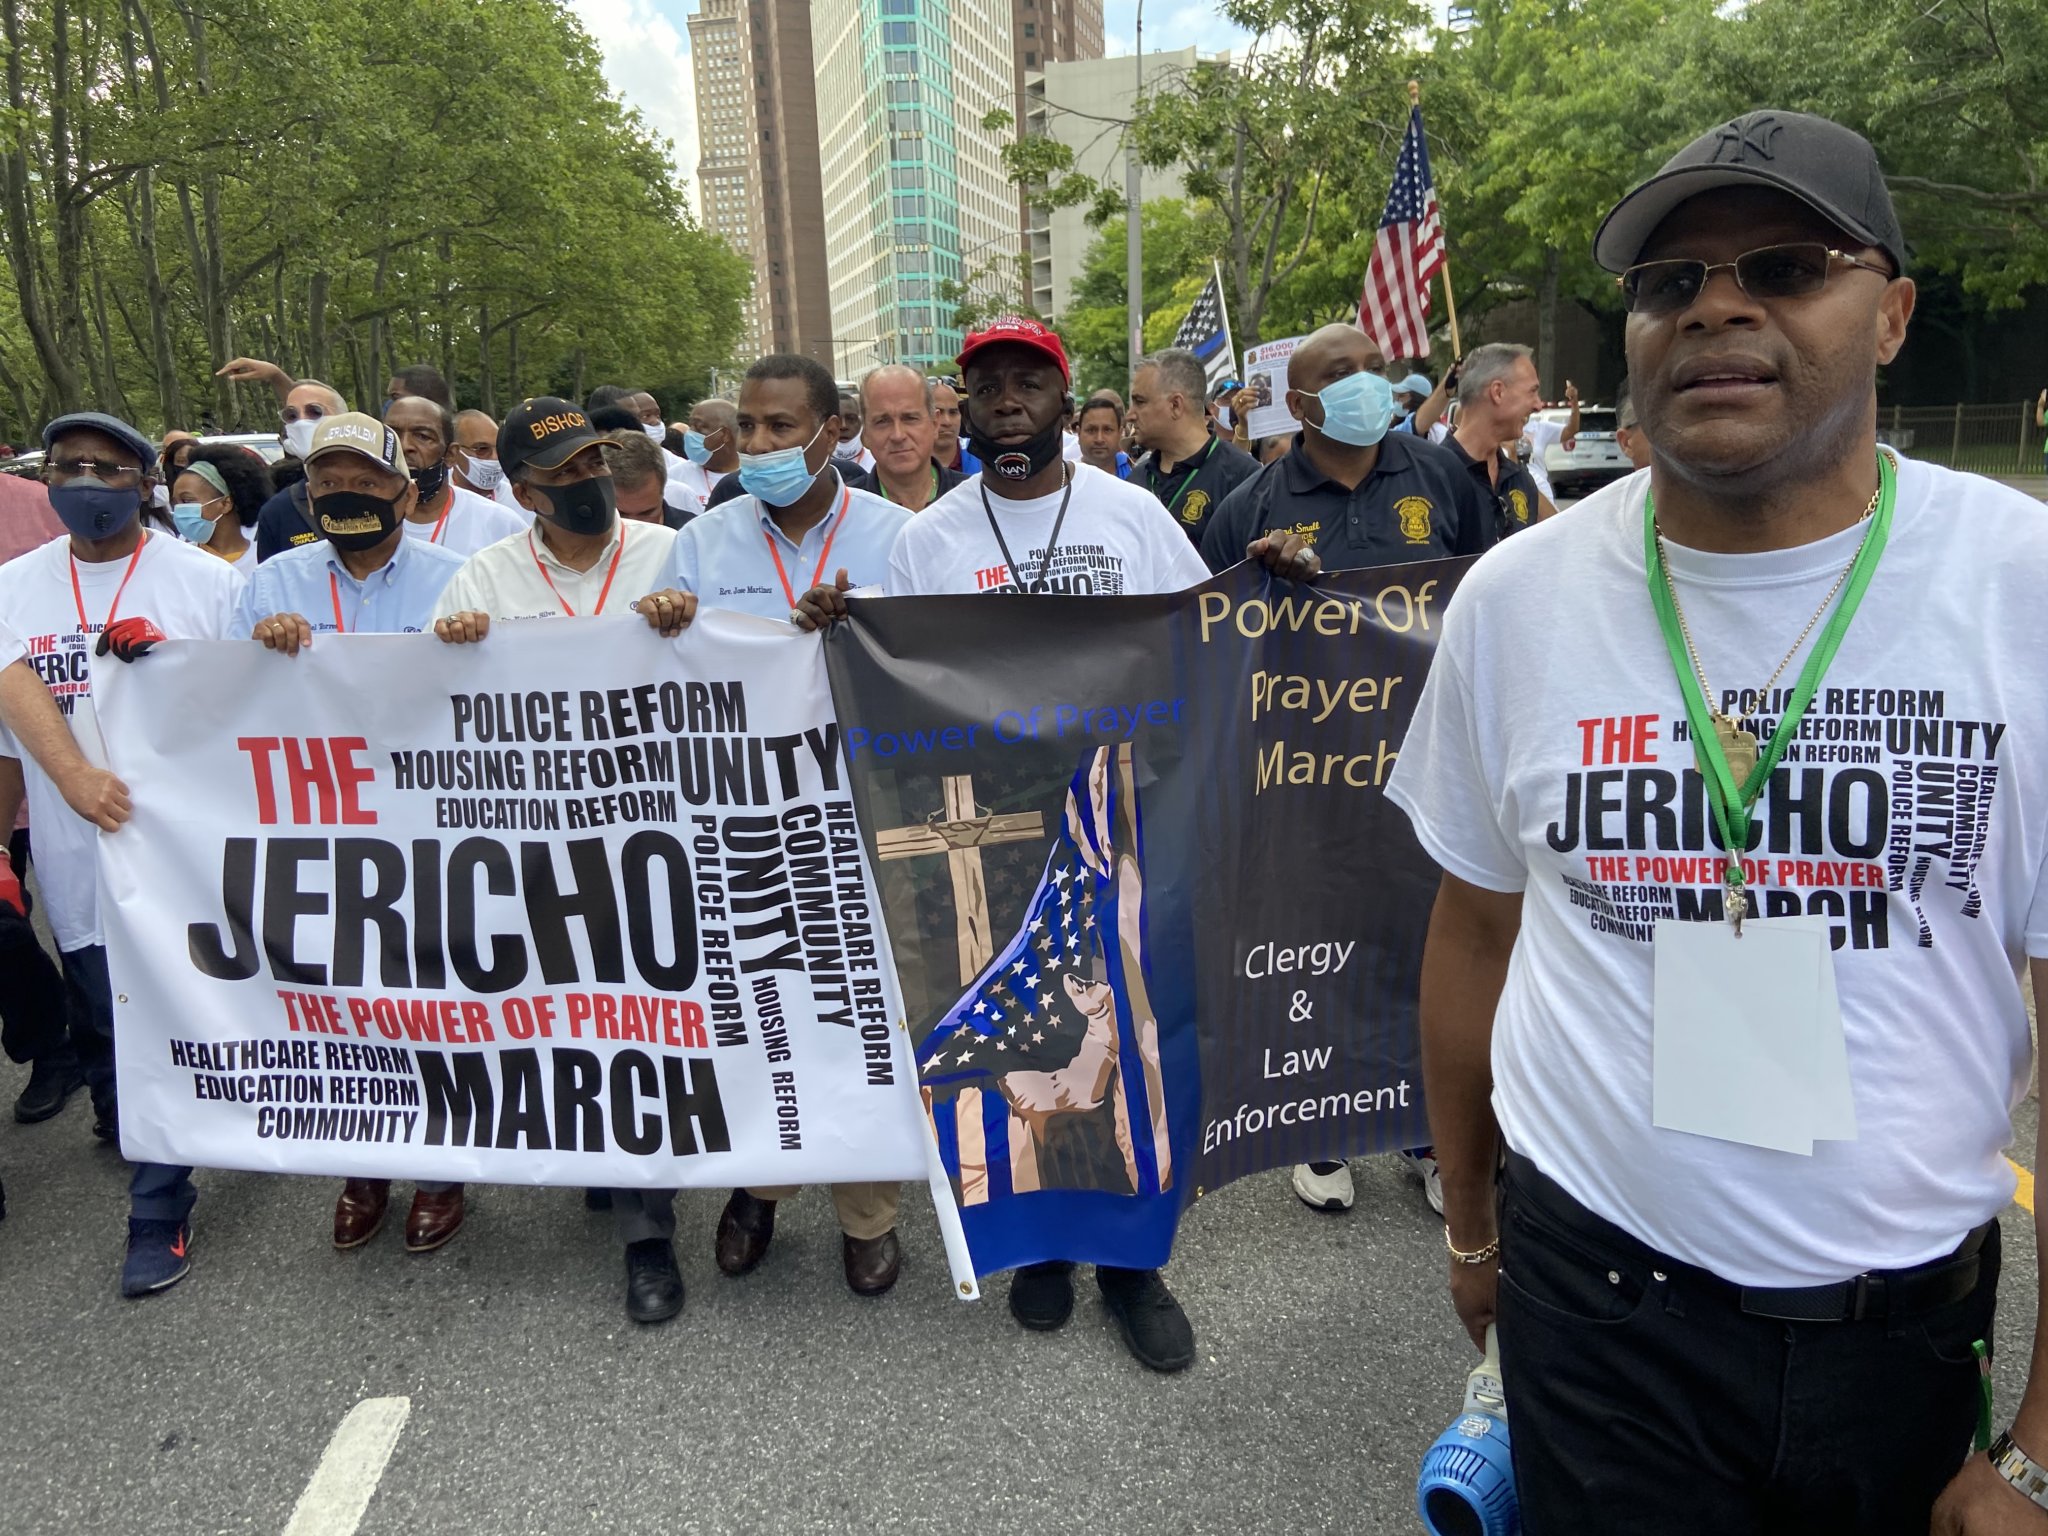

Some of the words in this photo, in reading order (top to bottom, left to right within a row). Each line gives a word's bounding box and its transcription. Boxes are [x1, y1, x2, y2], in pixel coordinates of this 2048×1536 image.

[530, 411, 586, 441] BISHOP
[1000, 463, 1026, 475] NAN
[1295, 521, 1320, 533] Small
[1053, 556, 1087, 567] REFORM
[1062, 565, 1088, 574] REFORM
[1065, 545, 1105, 556] REFORM
[1088, 555, 1123, 572] UNITY
[719, 588, 733, 596] Rev.
[974, 564, 1009, 590] THE
[1198, 591, 1363, 644] Power
[1375, 579, 1439, 634] Of
[28, 634, 58, 656] THE
[450, 690, 573, 743] POLICE
[580, 680, 748, 742] REFORM
[1251, 668, 1404, 724] Prayer
[1825, 688, 1944, 718] REFORM
[847, 723, 982, 761] Power
[993, 706, 1044, 744] Of
[1055, 697, 1186, 738] Prayer
[1577, 713, 1660, 766] THE
[1795, 718, 1882, 742] EFORM
[1886, 717, 2007, 761] UNITY
[390, 749, 526, 791] HOUSING
[534, 740, 676, 791] REFORM
[677, 722, 842, 807] UNITY
[1805, 744, 1881, 764] REFORM
[238, 736, 378, 825] THE
[1891, 759, 1913, 820] POLICE
[436, 797, 560, 831] EDUCATION
[564, 790, 678, 829] REFORM
[1913, 761, 1956, 860] UNITY
[1945, 763, 1980, 892] COMMUNITY
[1969, 765, 1999, 860] HEALTHCARE
[691, 814, 727, 921] POLICE
[1586, 855, 1638, 882] THE
[1640, 857, 1728, 885] POWER
[1742, 860, 1770, 886] OF
[1777, 860, 1884, 889] PRAYER
[1887, 824, 1912, 892] REFORM
[1909, 856, 1932, 903] HOUSING
[187, 830, 699, 994] JERICHO
[721, 814, 806, 975] UNITY
[780, 803, 856, 1029] COMMUNITY
[1570, 888, 1616, 918] EDUCATION
[1612, 885, 1673, 904] REFORM
[824, 800, 878, 973] HEALTHCARE
[852, 978, 895, 1087] REFORM
[1591, 912, 1656, 942] COMMUNI
[1244, 939, 1356, 980] Clergy
[702, 930, 749, 1048] REFORM
[1287, 989, 1314, 1023] &
[276, 989, 351, 1036] THE
[354, 996, 495, 1044] POWER
[503, 991, 571, 1041] OF
[575, 991, 709, 1049] PRAYER
[751, 975, 792, 1064] HOUSING
[170, 1038, 320, 1071] HEALTHCARE
[325, 1041, 414, 1075] REFORM
[1262, 1043, 1334, 1081] Law
[193, 1074, 324, 1105] EDUCATION
[329, 1076, 421, 1107] REFORM
[417, 1047, 733, 1157] MARCH
[771, 1070, 802, 1151] REFORM
[256, 1105, 419, 1146] COMMUNITY
[1201, 1078, 1411, 1157] Enforcement
